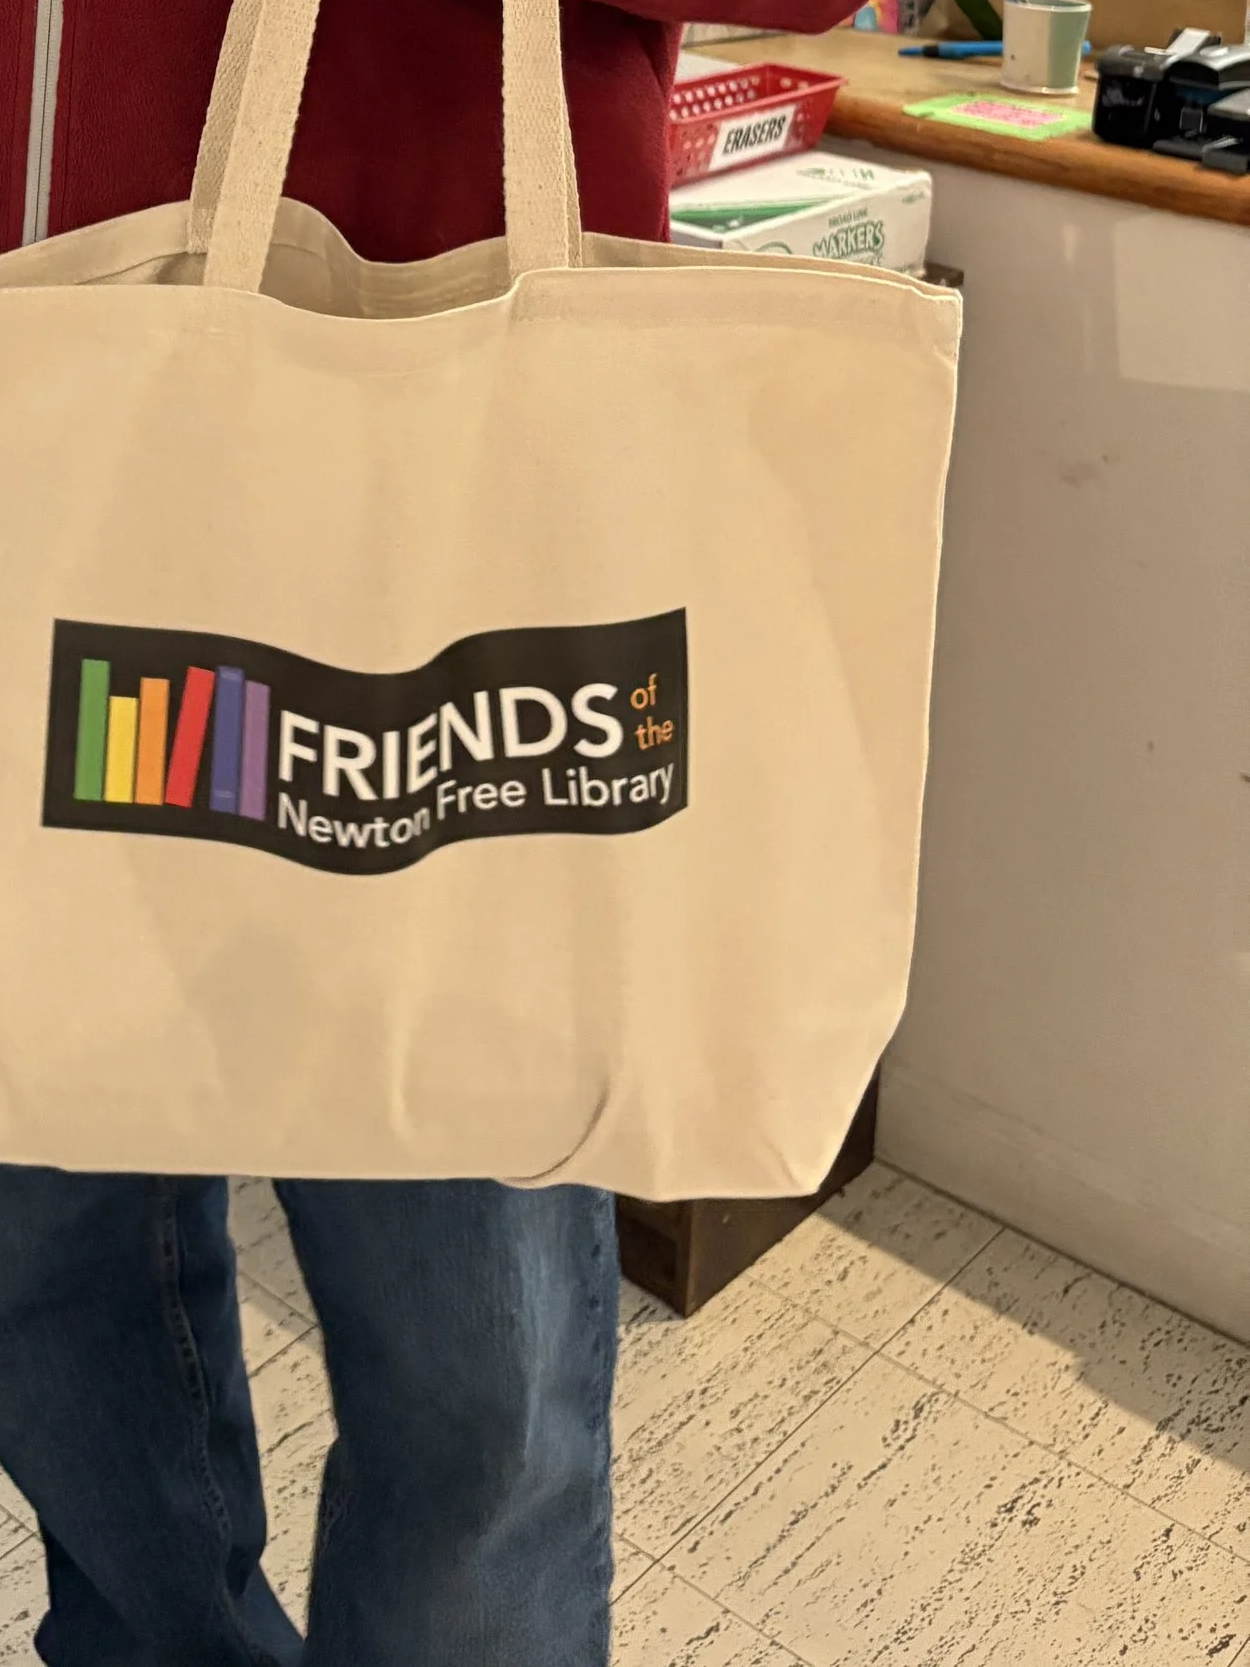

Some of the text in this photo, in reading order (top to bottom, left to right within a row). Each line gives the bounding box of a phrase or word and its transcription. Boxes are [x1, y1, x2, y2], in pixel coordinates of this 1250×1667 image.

[722, 115, 787, 156] ERASERS
[812, 220, 885, 259] MARKERS
[630, 673, 659, 711] of
[278, 682, 624, 800] FRIENDS
[635, 716, 674, 750] the
[278, 763, 675, 848] Newton Free Library
